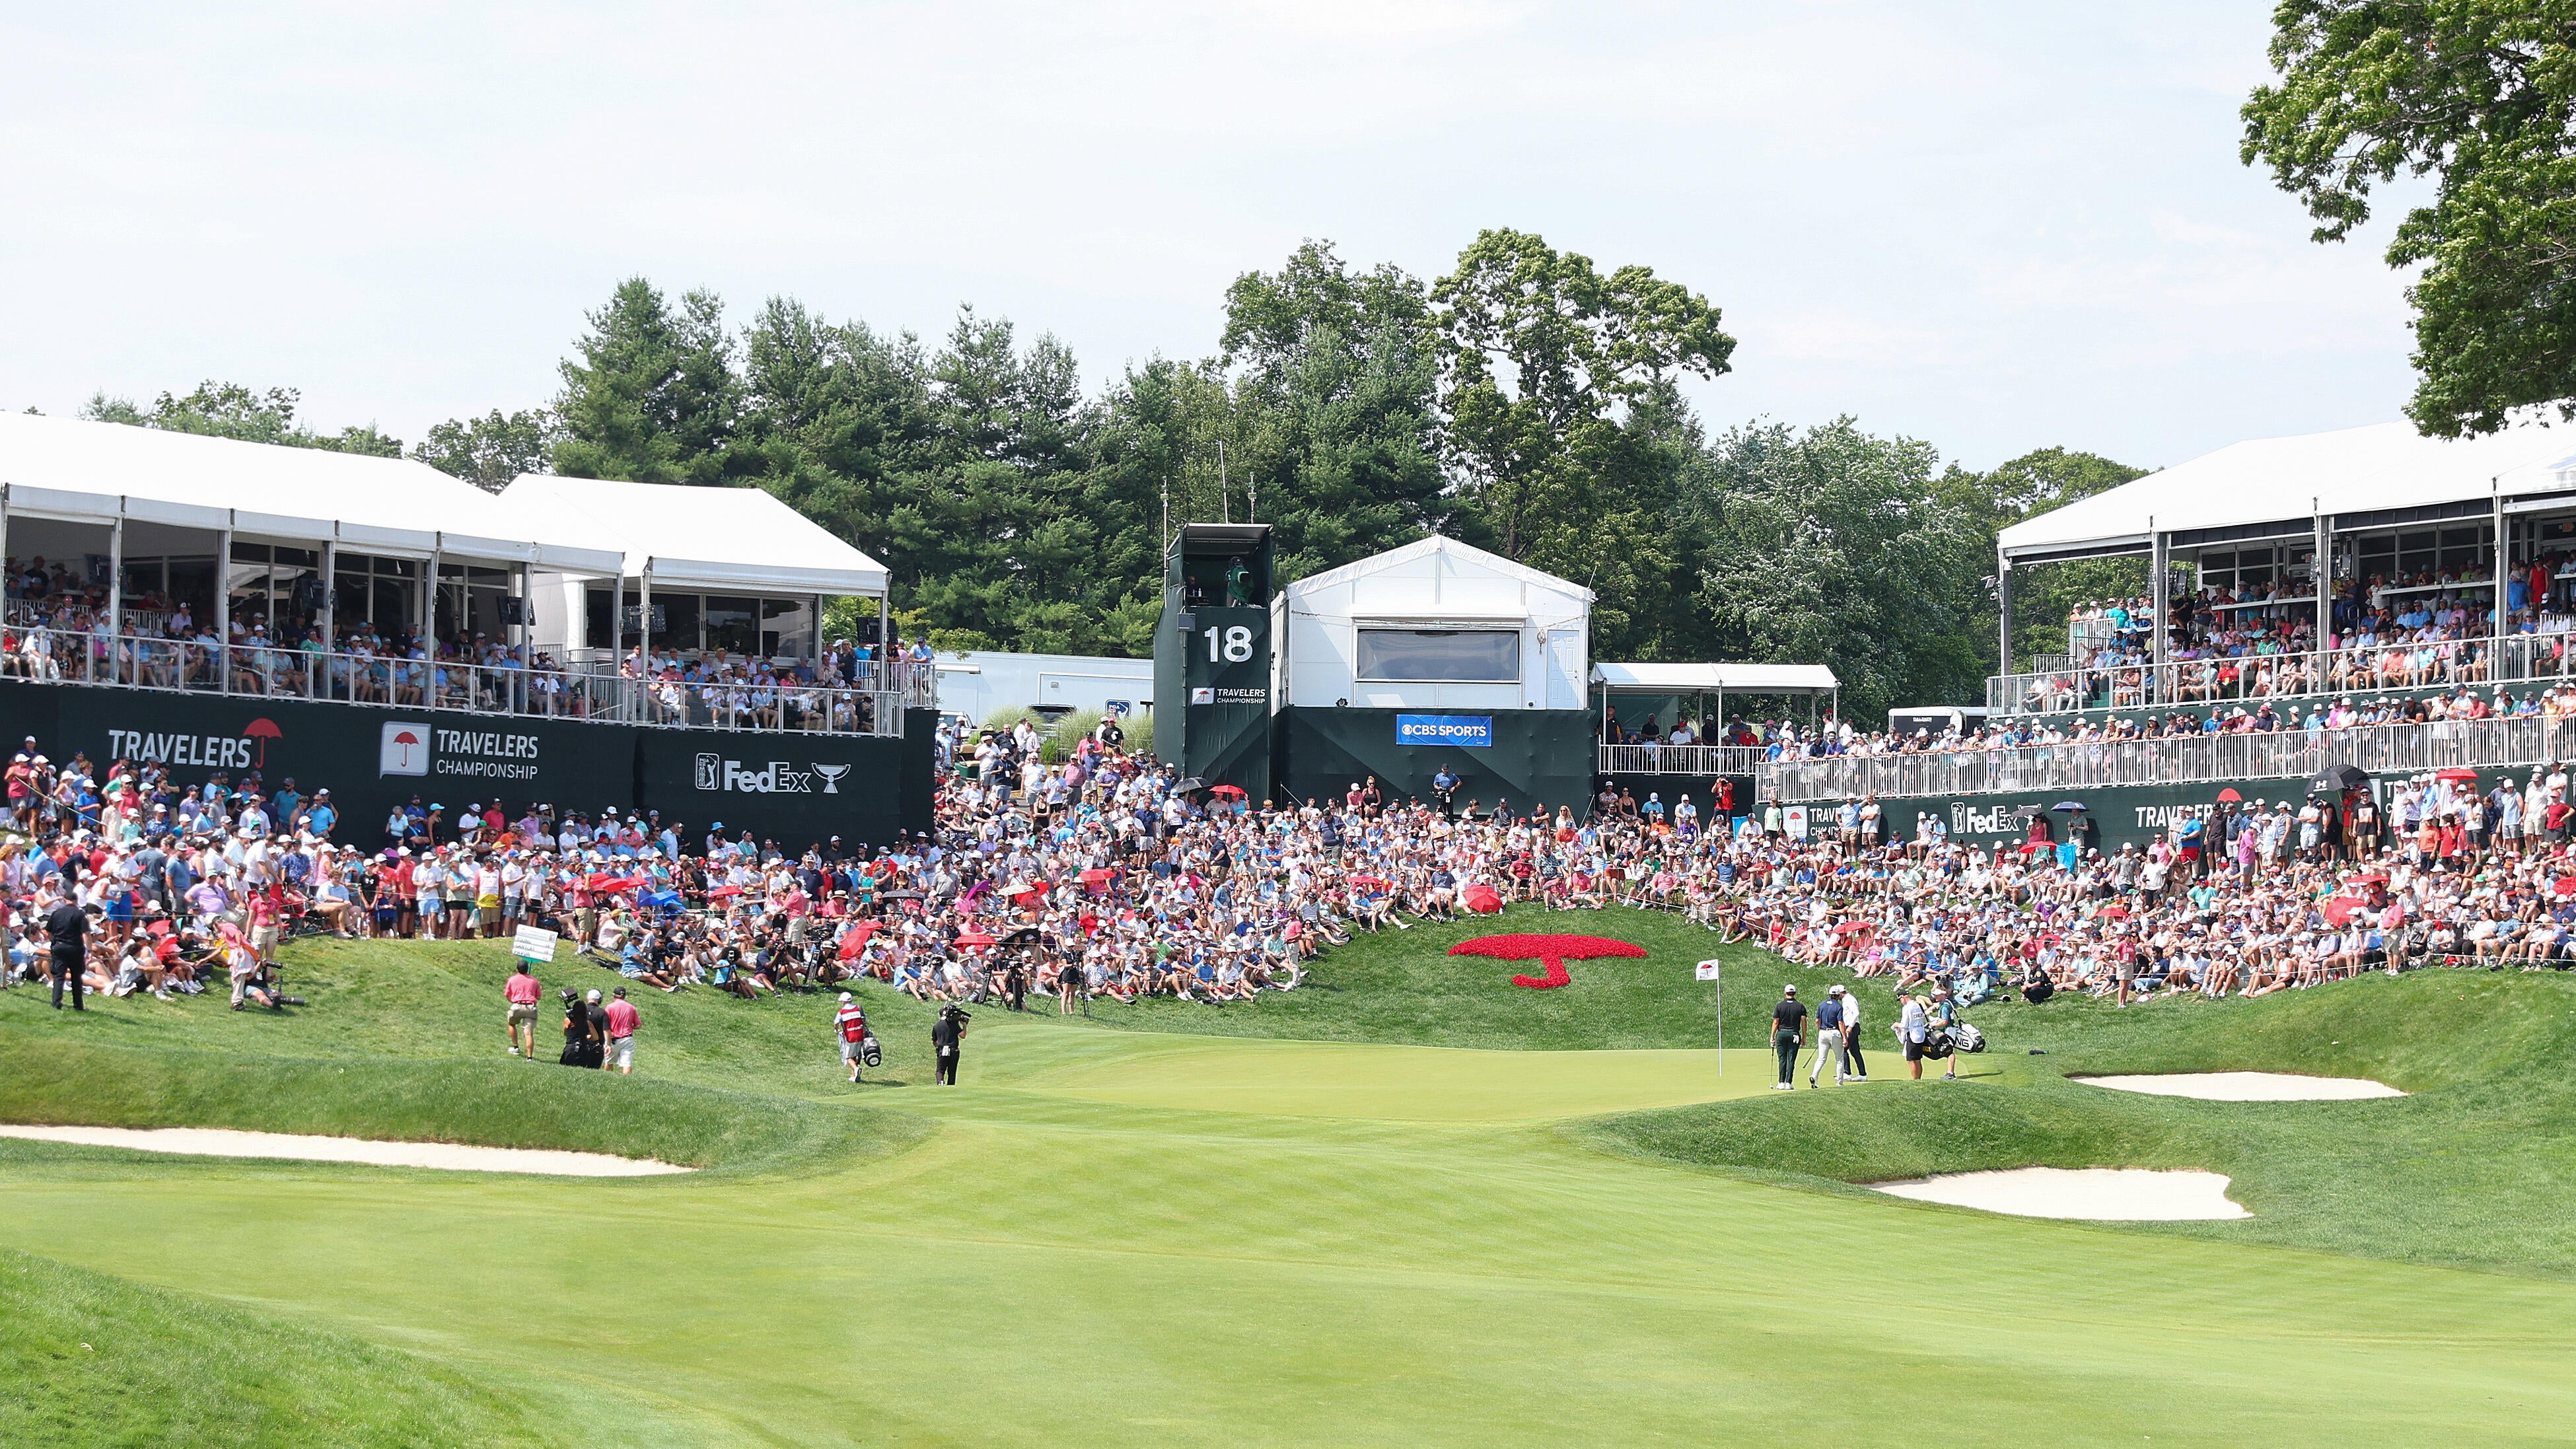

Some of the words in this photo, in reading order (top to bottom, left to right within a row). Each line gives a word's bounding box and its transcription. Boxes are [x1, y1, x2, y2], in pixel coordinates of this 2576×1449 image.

[1204, 625, 1253, 662] 18
[1217, 688, 1266, 697] TRAVELERS
[437, 729, 539, 759] TRAVELERS
[1412, 725, 1437, 736] CBS
[1439, 725, 1487, 737] SPORTS
[108, 729, 252, 769] TRAVELERS
[437, 760, 538, 780] CHAMPIONSHIP
[724, 760, 812, 793] FedEx
[1966, 805, 2020, 834] FedEx
